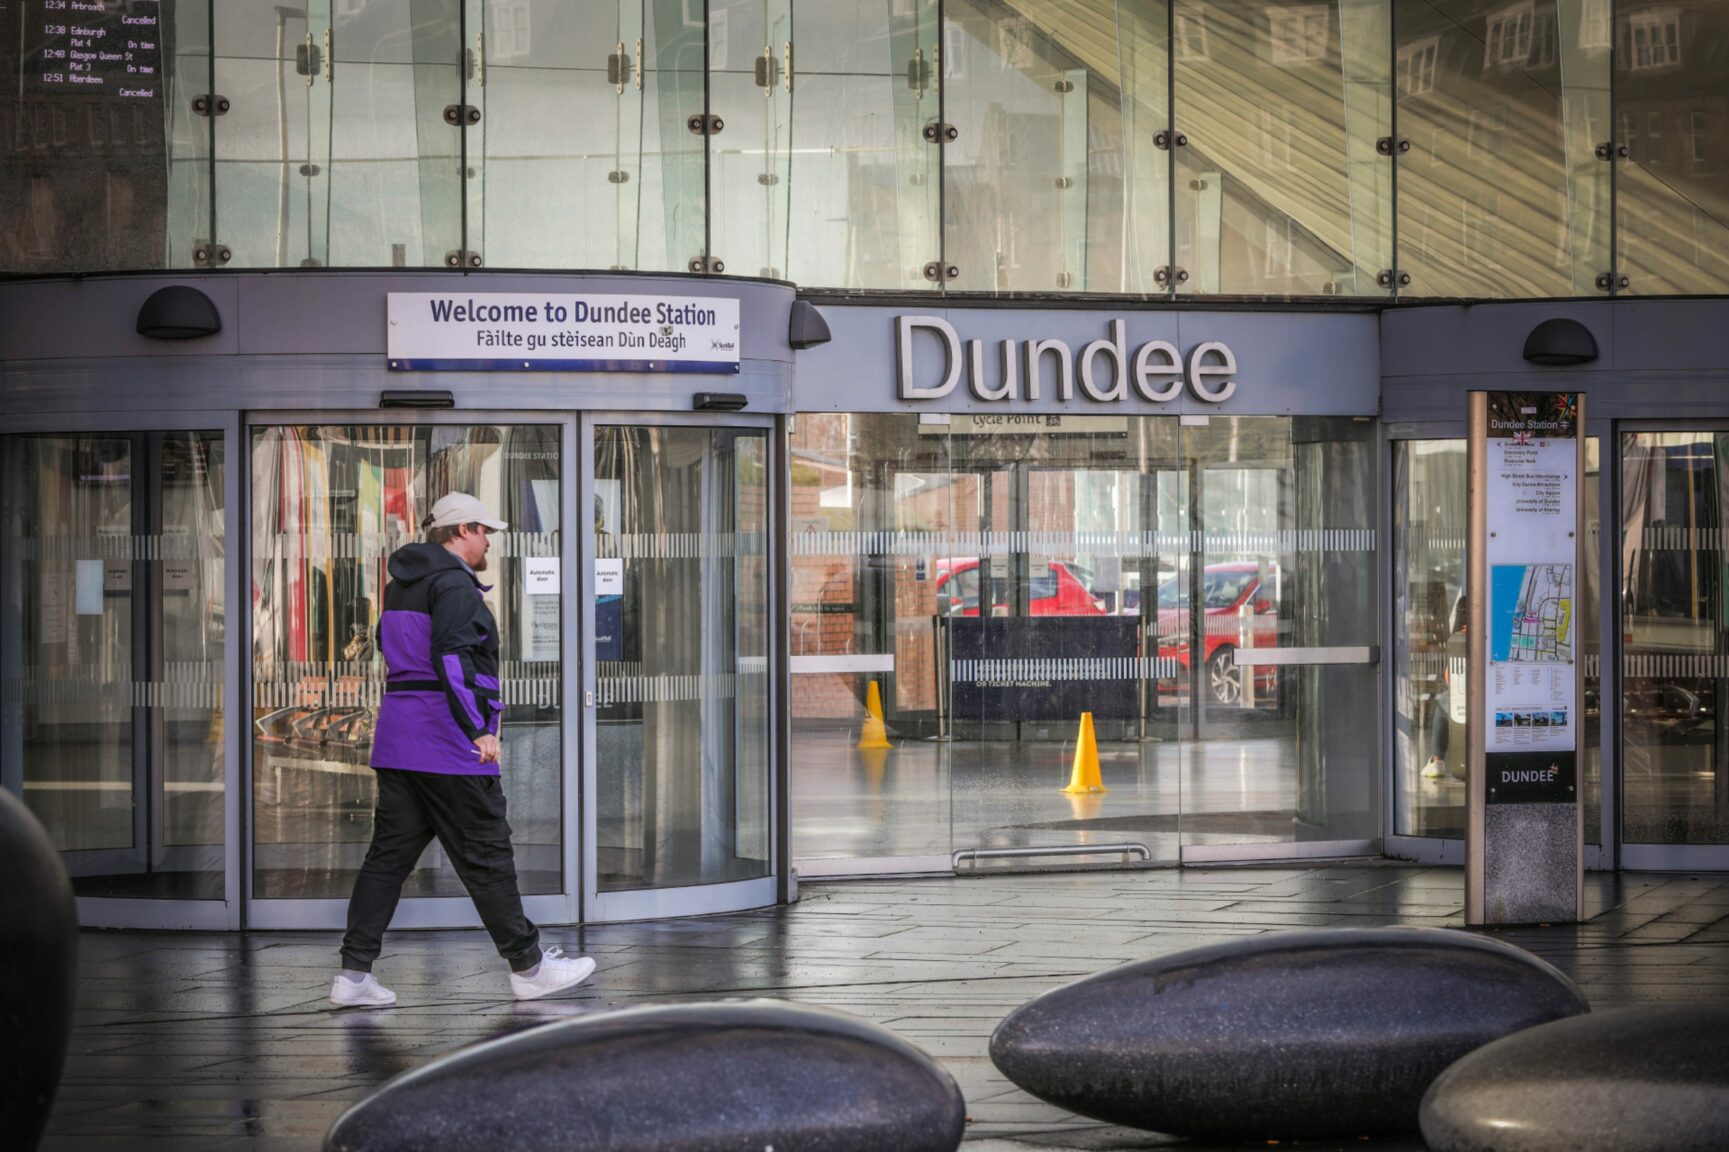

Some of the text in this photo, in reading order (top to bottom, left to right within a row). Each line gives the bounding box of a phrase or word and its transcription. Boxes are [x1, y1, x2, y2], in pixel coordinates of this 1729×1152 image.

[45, 1, 105, 11] 12:34 Arbroath
[122, 15, 156, 25] Cancelled
[44, 25, 106, 38] 12:38 Edinburgh
[71, 39, 155, 49] Plat 4 On time
[44, 49, 133, 61] 12:48 Glasgow Queen St
[70, 63, 154, 74] Plat 3 On time
[43, 73, 103, 84] 12:51 Aberdeen
[119, 88, 153, 97] Cancelled
[430, 298, 716, 326] Welcome to Dundee Station
[476, 329, 523, 347] Fàilte
[527, 334, 546, 351] gu
[551, 330, 613, 348] stèisean
[618, 330, 645, 348] Dùn
[894, 315, 1238, 402] Dundee
[972, 414, 1041, 427] Cycle Point
[1491, 419, 1558, 430] Dundee Station
[505, 452, 559, 460] DUNDEE STATIO
[1501, 769, 1555, 782] DUNDEE
